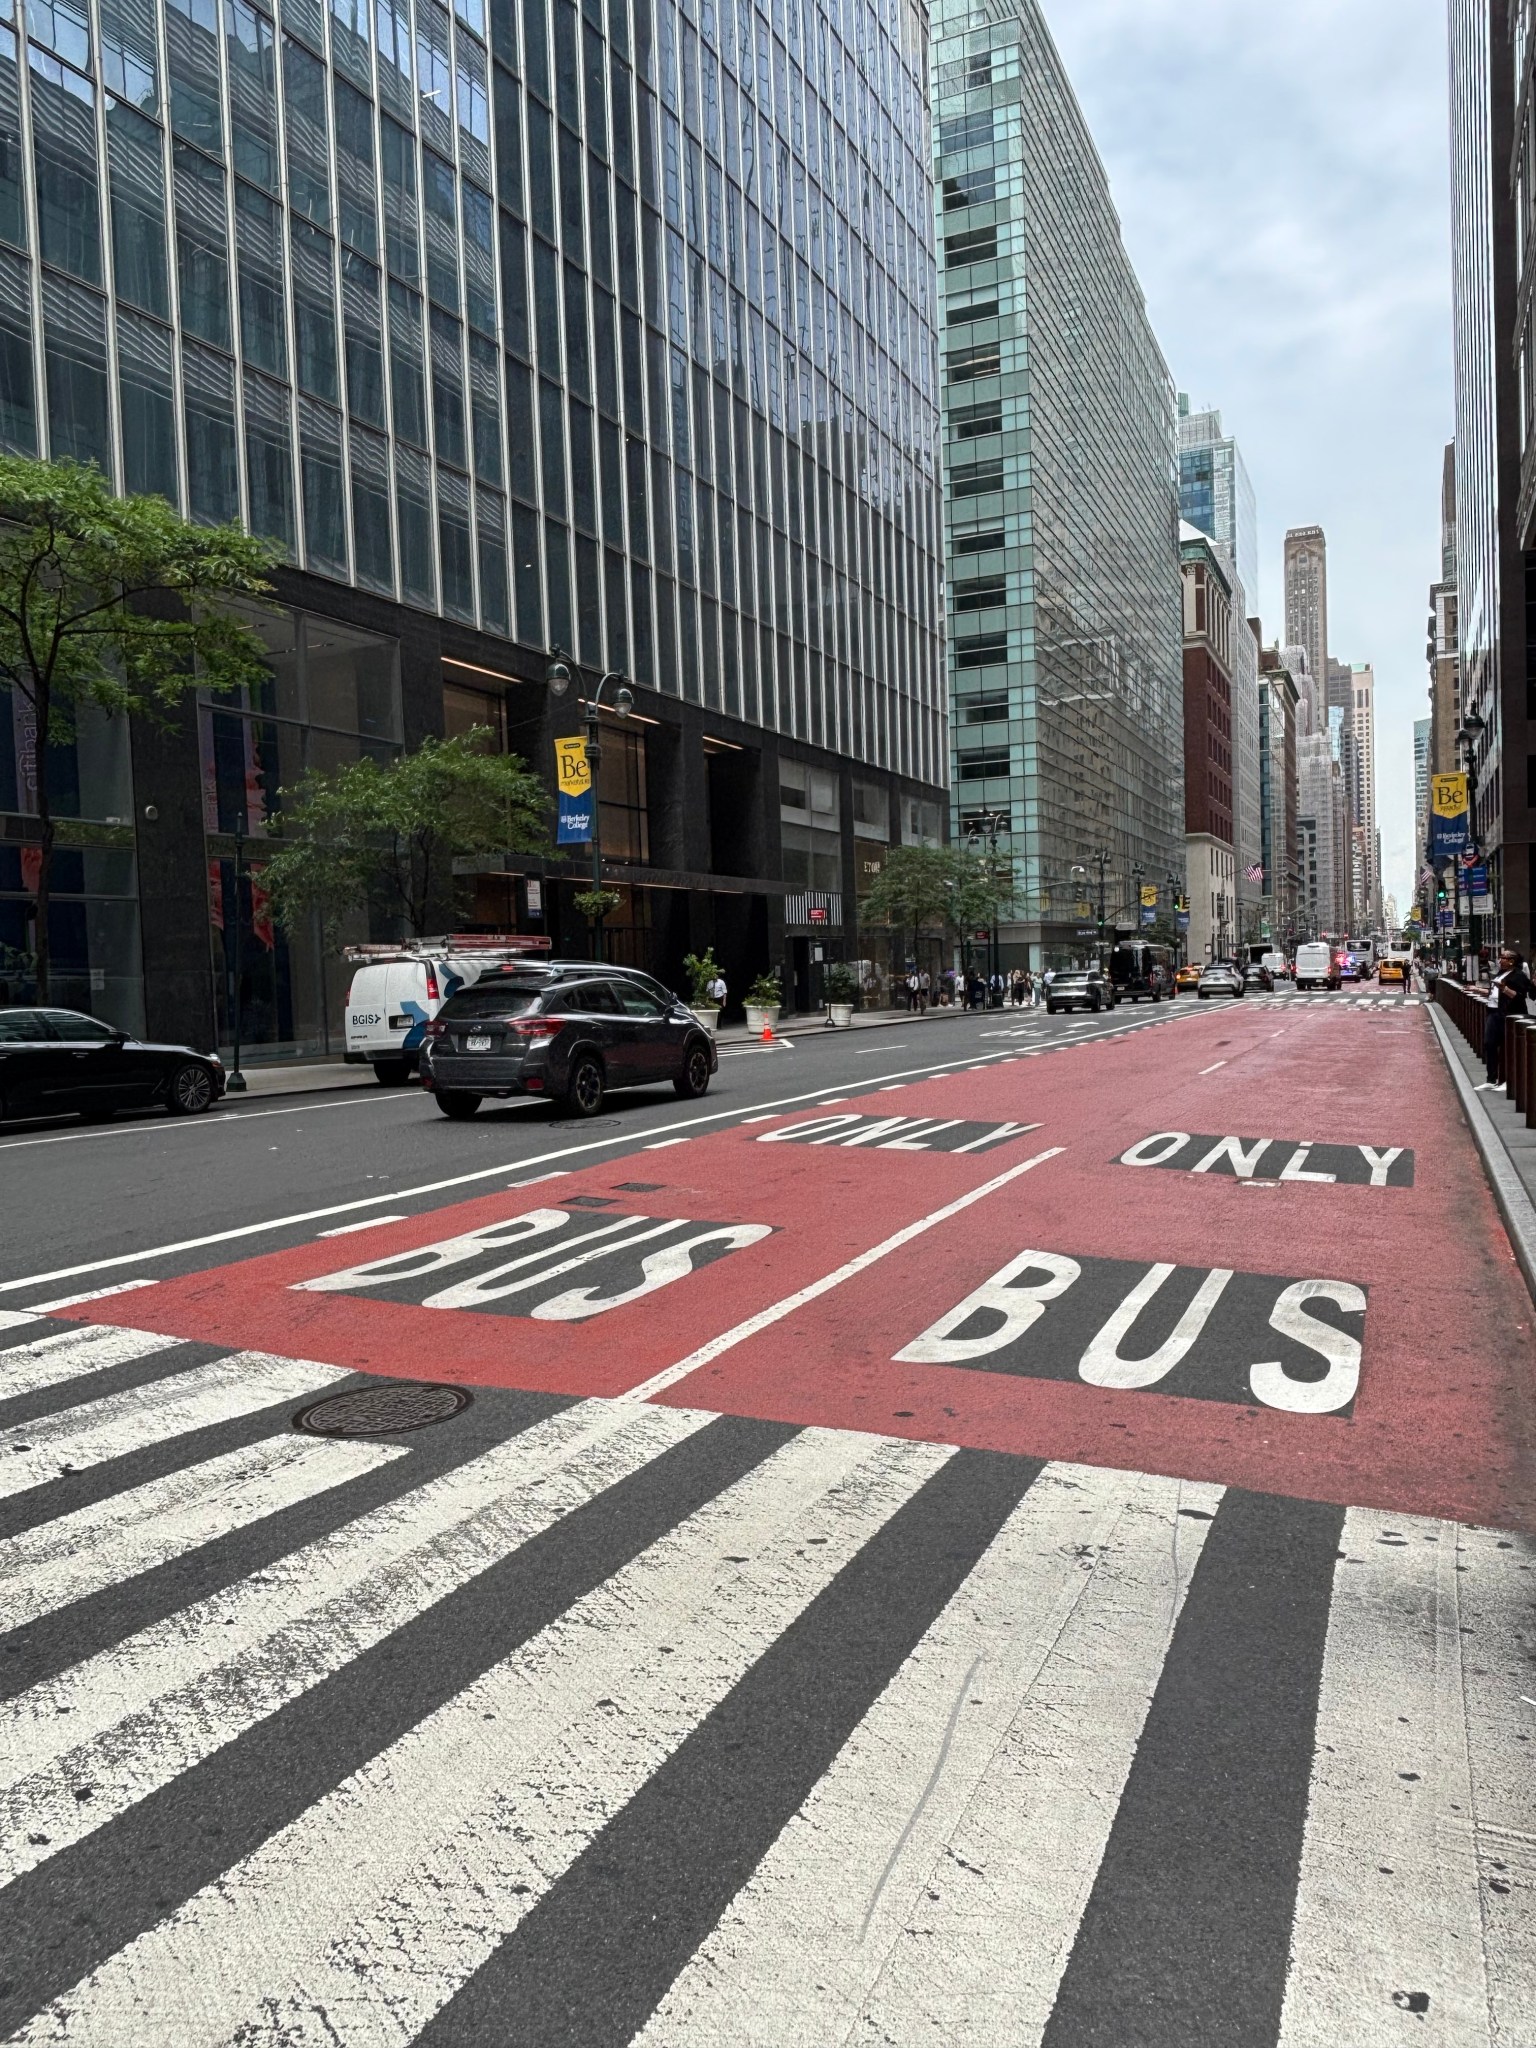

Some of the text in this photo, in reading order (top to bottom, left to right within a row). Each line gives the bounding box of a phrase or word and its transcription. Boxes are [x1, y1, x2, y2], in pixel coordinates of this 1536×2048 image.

[19, 699, 38, 792] citibank
[560, 754, 589, 779] Be
[1438, 786, 1464, 805] Be
[566, 813, 590, 824] Berkeley
[567, 822, 588, 830] College
[352, 1014, 374, 1025] BGIS
[755, 1113, 1045, 1153] ONLY
[1119, 1132, 1404, 1186] ONLY
[286, 1208, 773, 1321] BUS
[890, 1249, 1367, 1413] BUS
